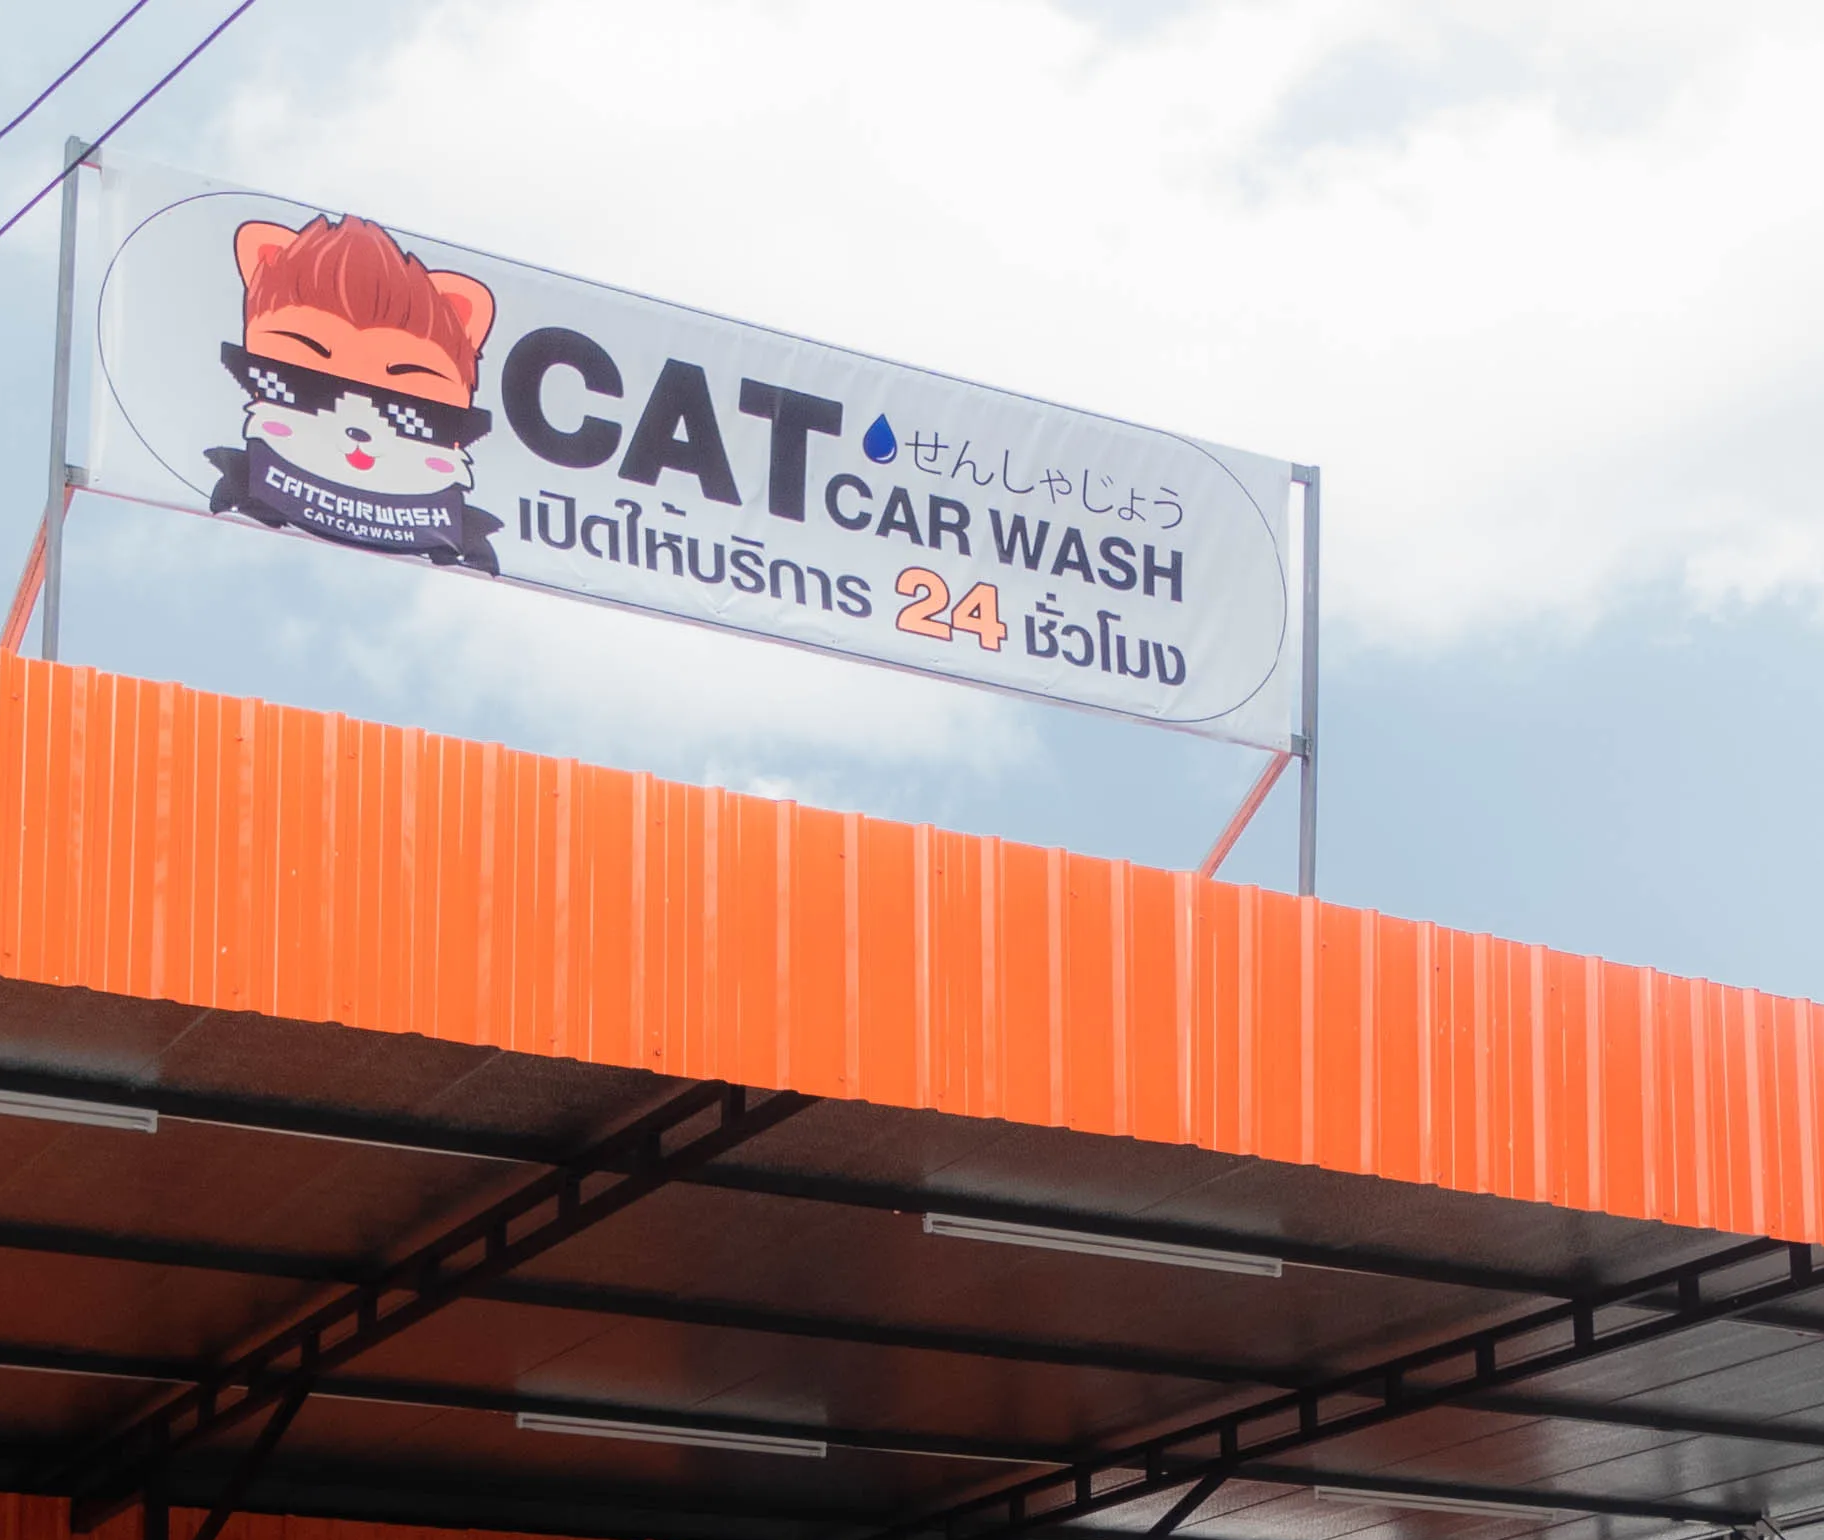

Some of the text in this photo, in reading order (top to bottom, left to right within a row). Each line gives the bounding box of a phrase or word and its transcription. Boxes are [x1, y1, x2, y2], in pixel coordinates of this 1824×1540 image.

[501, 326, 844, 523] CAT
[905, 430, 1183, 530] せんしゃじょう
[265, 466, 451, 527] CATCARWASH
[303, 507, 415, 543] CATCARWASH
[825, 473, 1183, 603] CAR WASH
[519, 490, 1187, 686] เปิดให้บริการ 24 ชั่วโมง
